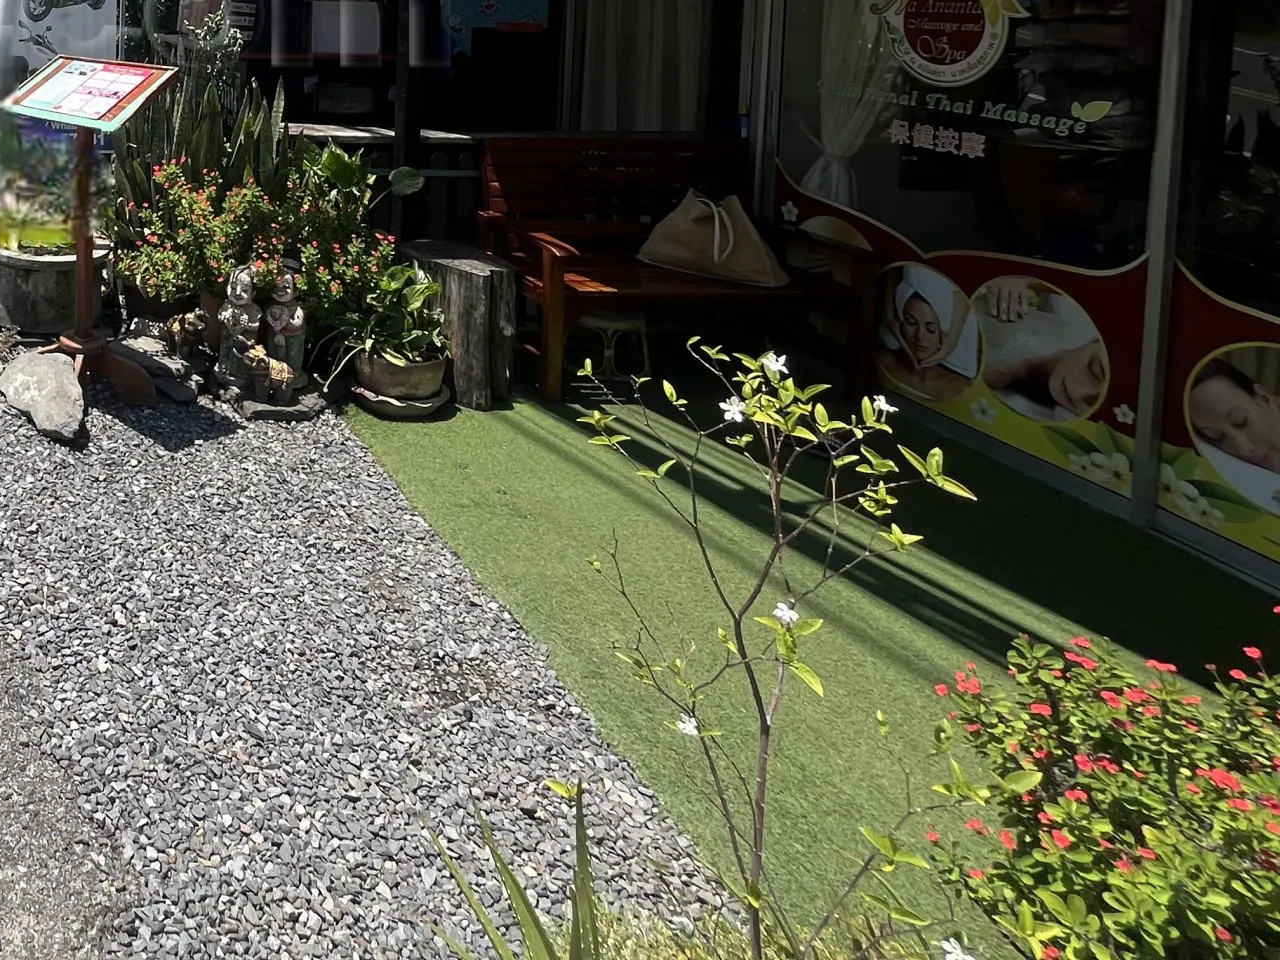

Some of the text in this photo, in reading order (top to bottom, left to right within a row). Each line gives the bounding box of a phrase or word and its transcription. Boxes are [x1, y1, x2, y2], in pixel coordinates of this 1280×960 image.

[960, 19, 984, 31] and
[916, 34, 967, 63] Spa
[925, 91, 974, 116] Thai
[980, 100, 1088, 137] Massage
[889, 118, 987, 159] 保健按摩
